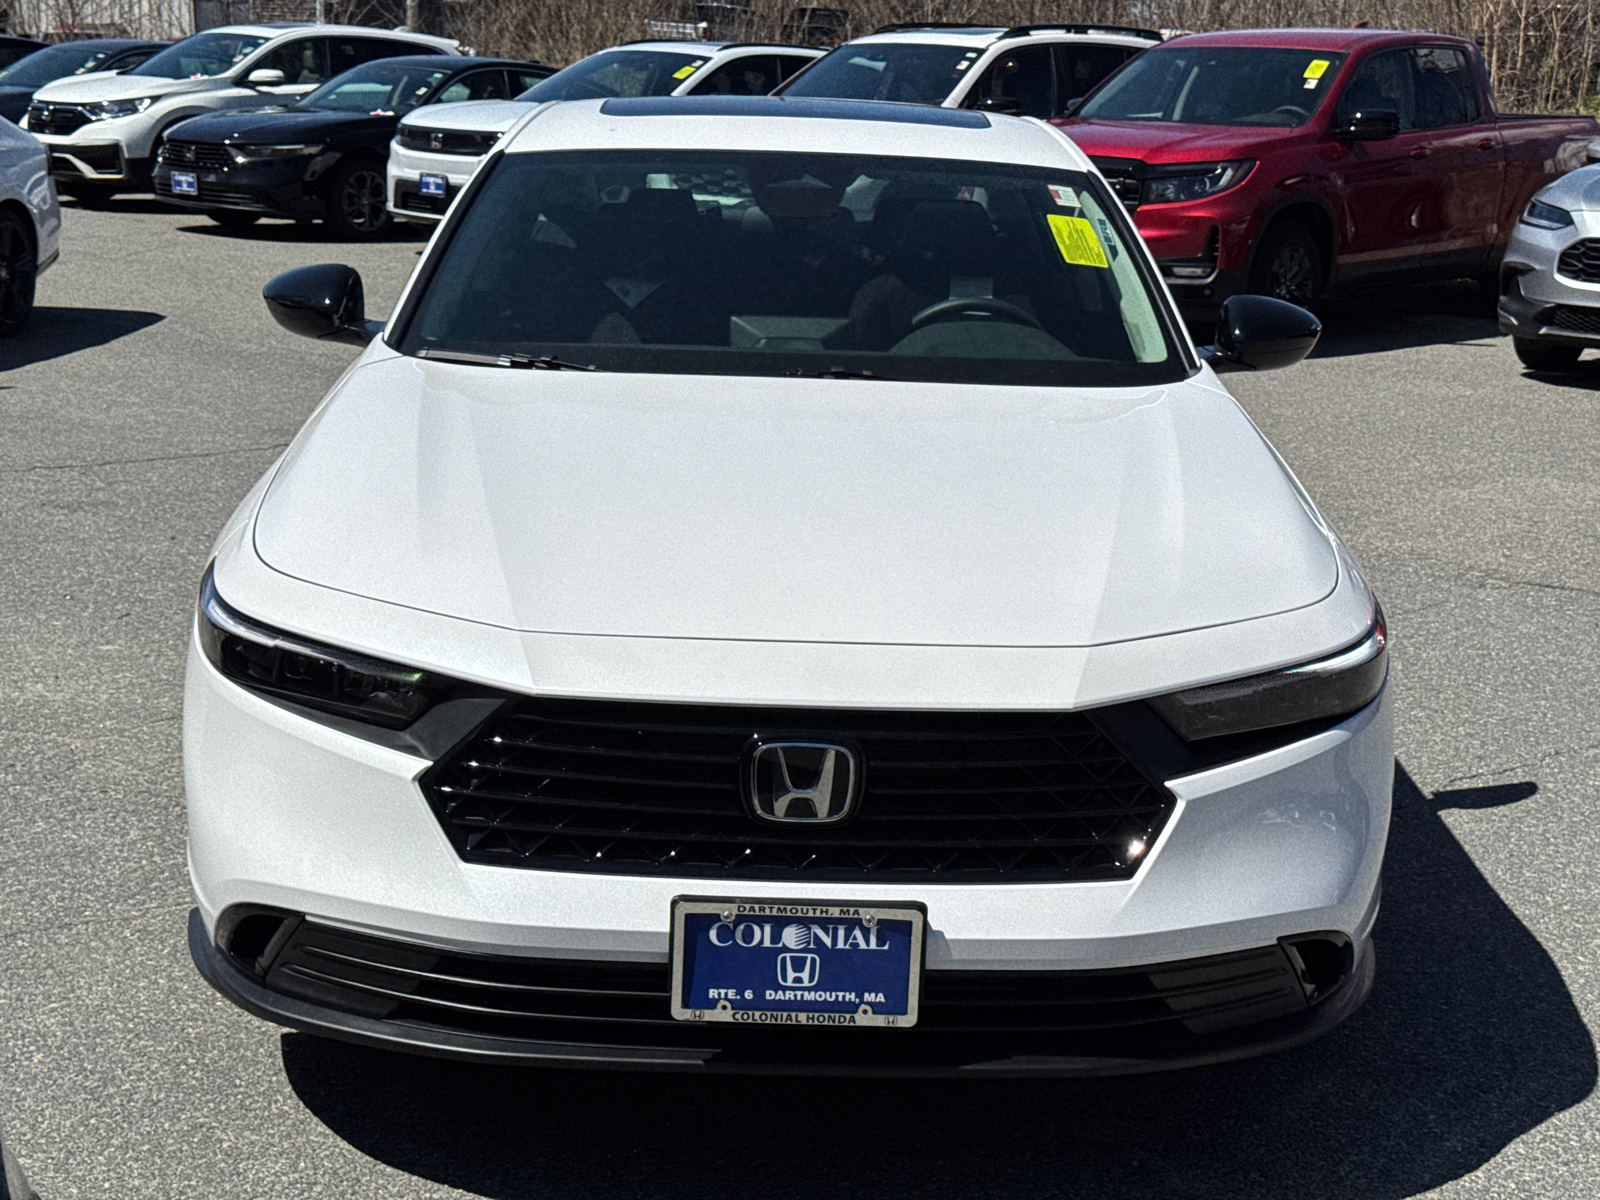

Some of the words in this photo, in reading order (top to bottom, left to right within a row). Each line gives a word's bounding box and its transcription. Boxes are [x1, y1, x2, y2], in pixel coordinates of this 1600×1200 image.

[839, 908, 861, 917] MA
[708, 921, 890, 950] COLONIAL
[708, 988, 741, 1000] RTE.
[744, 989, 754, 1000] 6
[765, 989, 860, 1004] DARTMOUTH,
[863, 992, 886, 1003] MA
[731, 1011, 802, 1024] COLONIAL
[806, 1013, 856, 1025] HONDA
